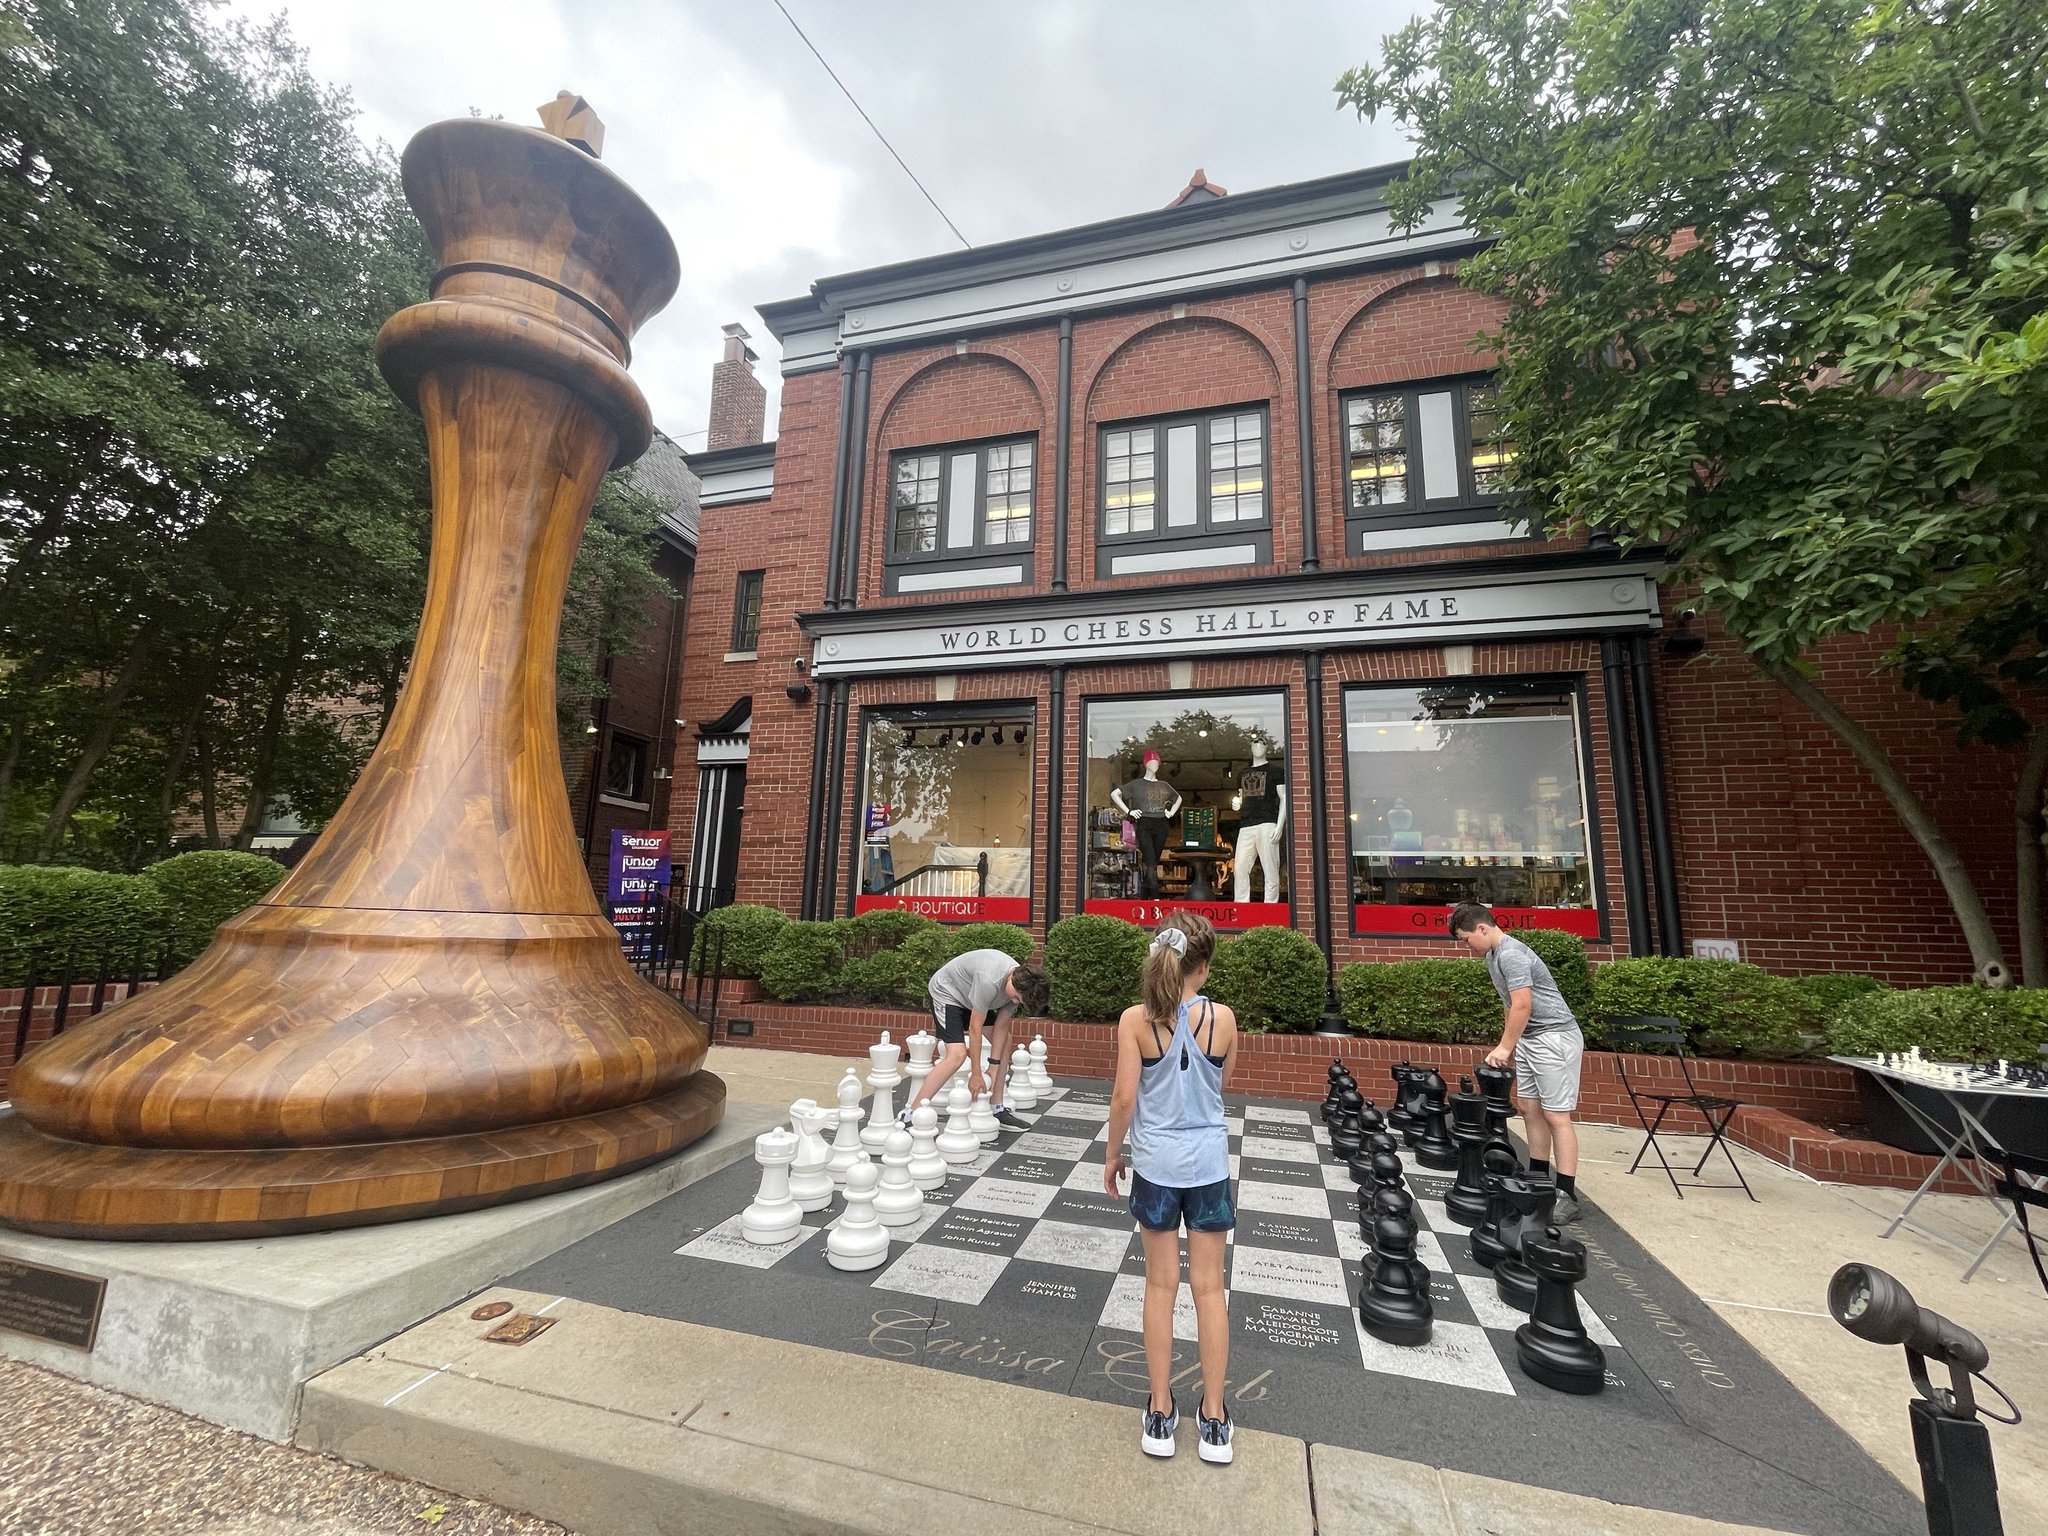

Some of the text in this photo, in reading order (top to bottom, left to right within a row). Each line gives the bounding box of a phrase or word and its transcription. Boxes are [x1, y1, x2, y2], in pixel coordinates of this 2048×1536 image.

[940, 627, 1046, 650] WORLD
[1063, 618, 1172, 641] CHESS
[1195, 610, 1287, 632] HALL
[1354, 597, 1458, 622] FAME
[621, 837, 662, 846] senior
[622, 857, 659, 873] junior
[912, 901, 985, 915] BOUTIQUE
[1132, 906, 1145, 919] Q
[1412, 912, 1427, 927] Q
[1086, 1205, 1127, 1214] Pillsbury
[979, 1218, 1021, 1227] Reichert
[941, 1223, 1017, 1238] Sachin Agrawal
[1252, 1230, 1318, 1242] FOUNDATION
[1286, 1265, 1321, 1274] Aspire
[1240, 1270, 1338, 1288] FleishmanHillard
[1020, 1286, 1077, 1299] SHAHADE
[1027, 1280, 1077, 1292] JENNIFER
[1261, 1305, 1320, 1319] CABANNE
[1262, 1312, 1320, 1326] HOWARD
[1245, 1316, 1338, 1337] KALEIDOSCOPE
[1244, 1324, 1340, 1344] MANAGEMENT
[1269, 1335, 1315, 1348] GROUP
[1445, 1344, 1471, 1353] JILL
